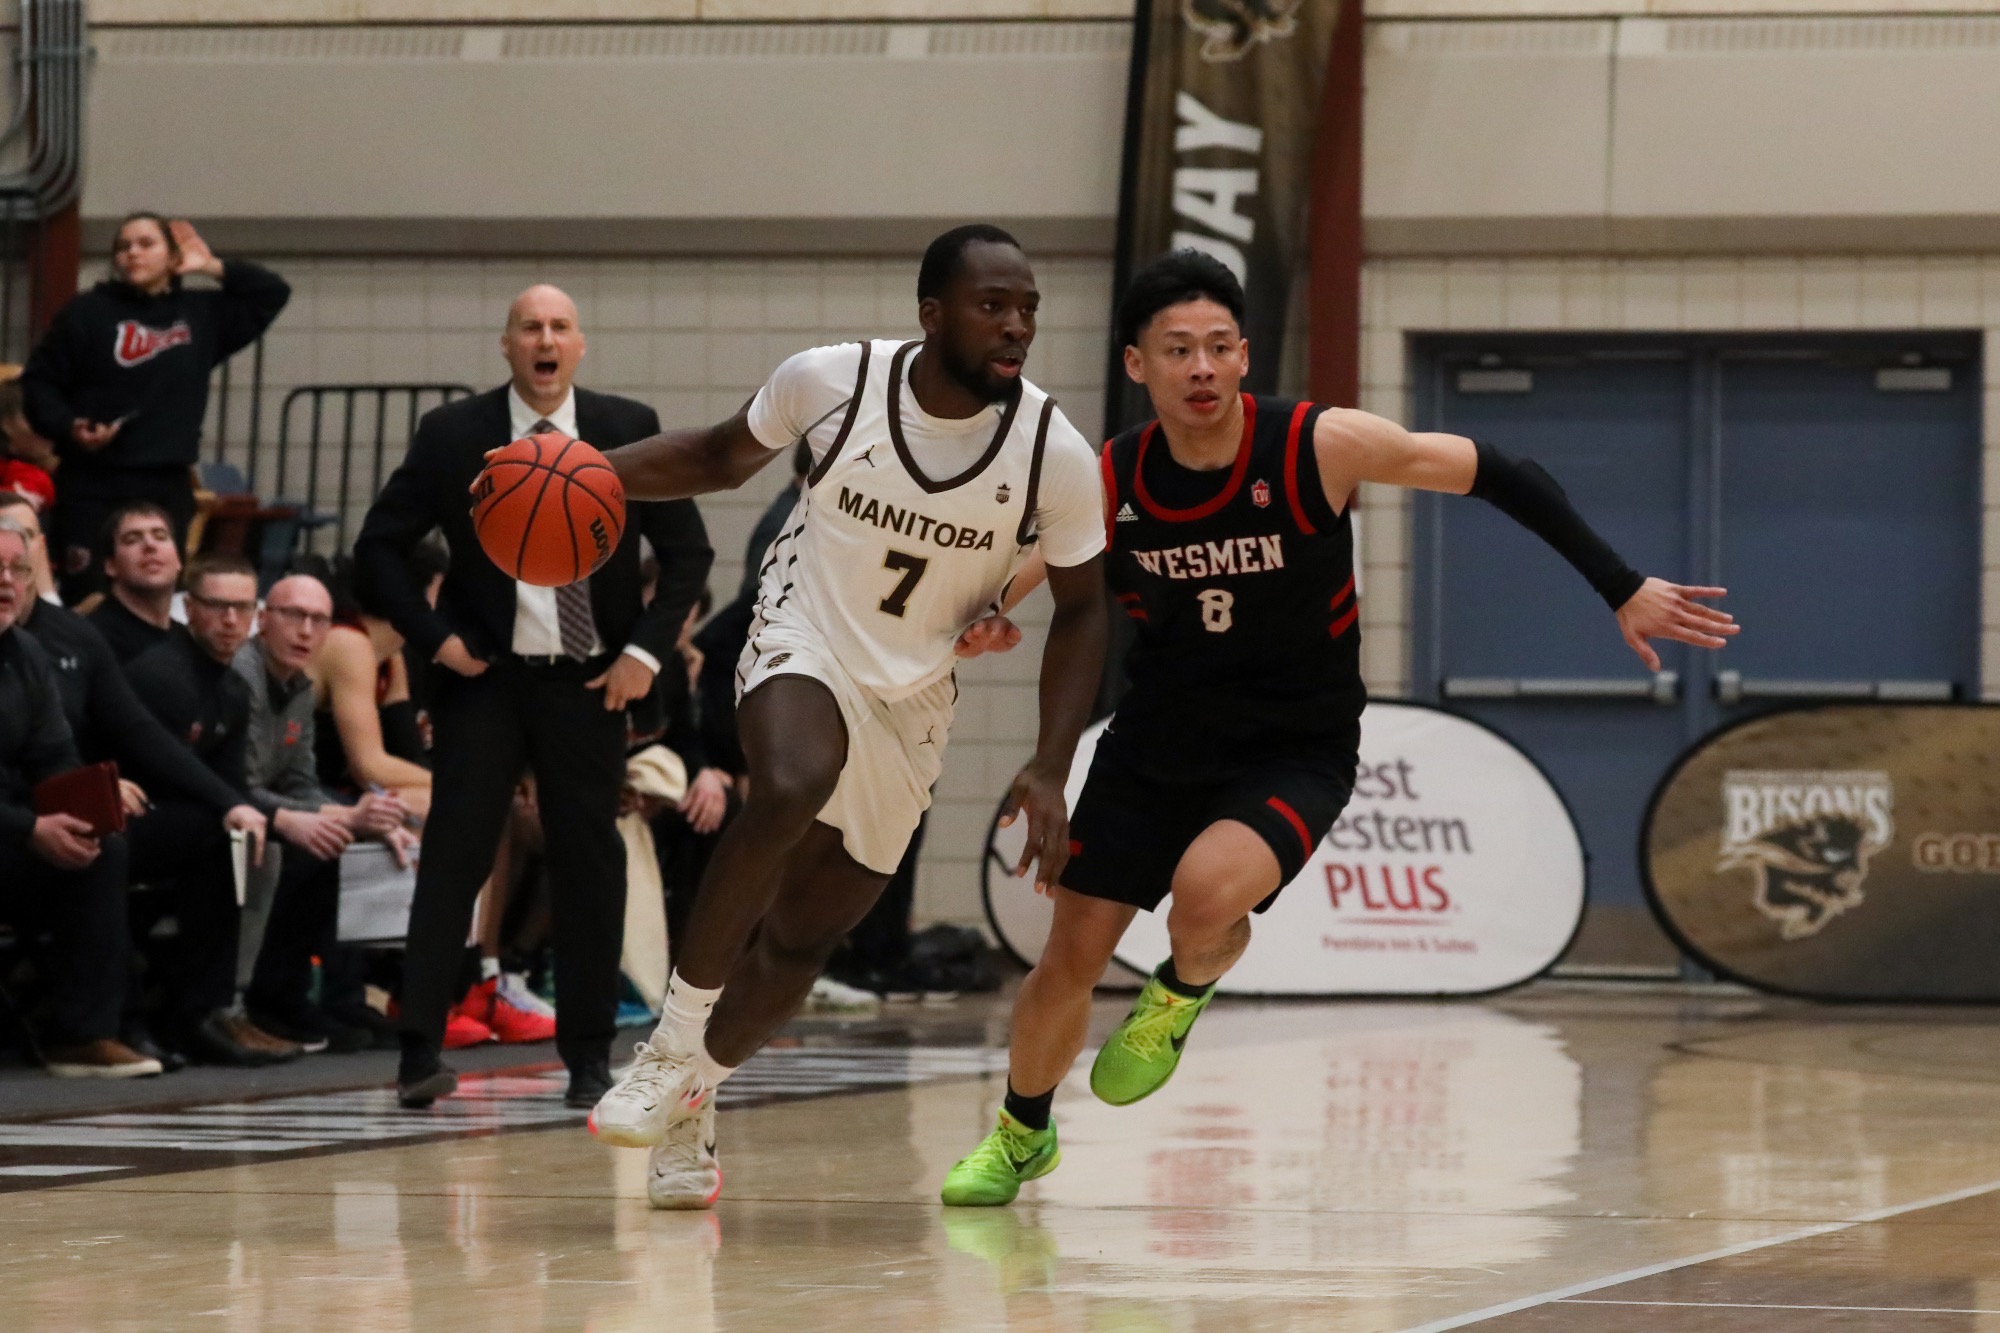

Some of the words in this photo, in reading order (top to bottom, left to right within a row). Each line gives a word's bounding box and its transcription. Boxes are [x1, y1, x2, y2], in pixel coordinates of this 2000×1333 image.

[838, 486, 995, 551] MANITOBA
[1130, 534, 1285, 579] WESMEN
[876, 546, 930, 619] 7
[1196, 588, 1234, 633] 8
[1353, 757, 1419, 800] est
[1327, 809, 1474, 854] estern
[1722, 771, 1893, 850] BISONS
[1323, 863, 1451, 912] PLUS
